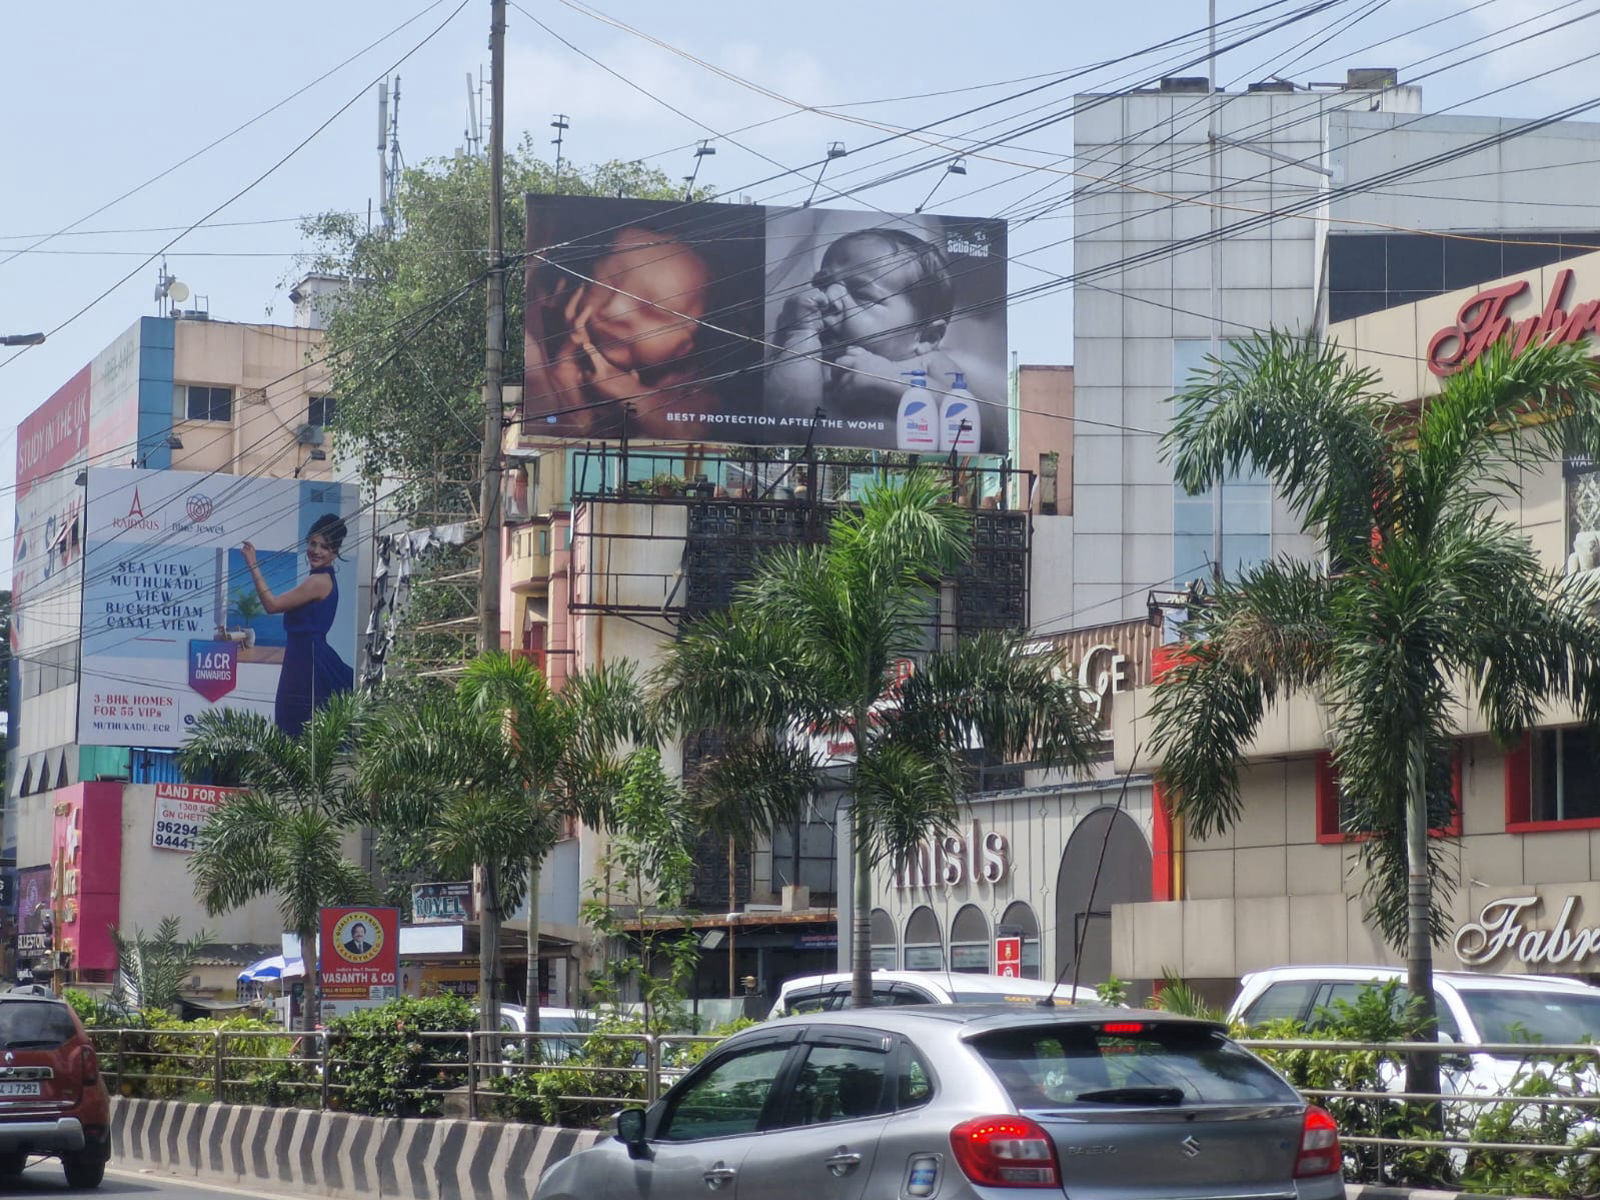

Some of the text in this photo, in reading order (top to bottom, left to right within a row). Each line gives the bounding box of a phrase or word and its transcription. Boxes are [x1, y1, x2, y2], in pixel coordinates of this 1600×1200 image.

[667, 412, 695, 422] BEST
[700, 414, 776, 425] PROTECTION
[822, 418, 844, 429] THE
[847, 420, 885, 431] WOMB
[19, 388, 87, 475] STUDY IN THE UK
[118, 562, 196, 577] SEA VIEW.
[110, 575, 203, 591] MUTHUKADU
[106, 602, 203, 618] BUCKINGHAM
[107, 616, 204, 632] CANAL VIEW.
[195, 652, 231, 670] 1.6 CR
[195, 669, 231, 681] ONWARDS
[93, 693, 173, 707] 3-BHK HOMES
[93, 705, 162, 718] FOR 55 VIPs
[153, 722, 170, 732] ECR
[158, 784, 189, 799] LAND
[193, 787, 215, 802] FOR
[162, 809, 175, 818] GN
[322, 972, 395, 983] VASANTH & CO
